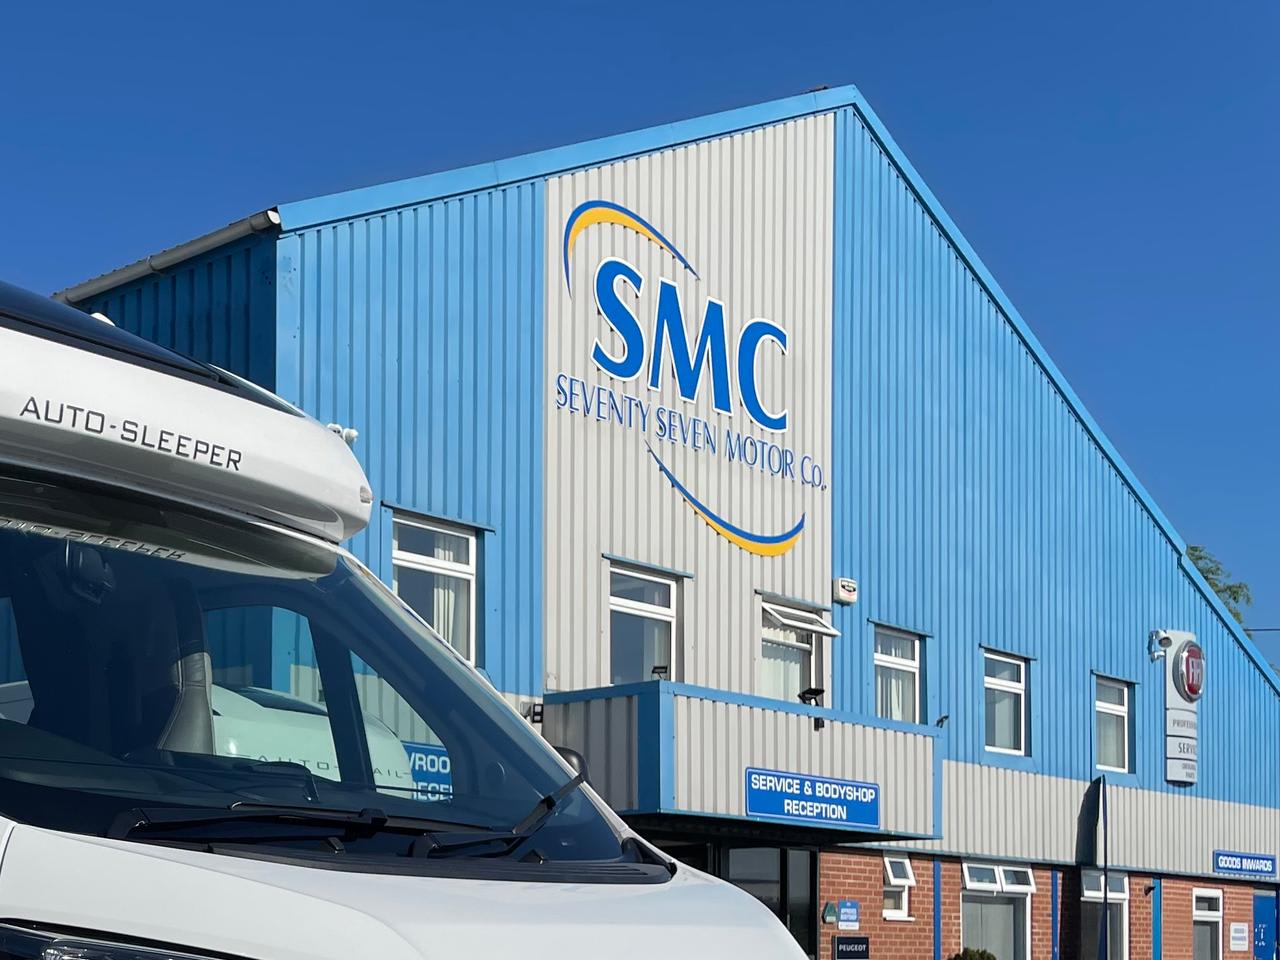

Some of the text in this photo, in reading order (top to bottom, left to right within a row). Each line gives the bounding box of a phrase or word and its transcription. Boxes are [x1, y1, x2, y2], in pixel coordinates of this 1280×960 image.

[591, 257, 789, 433] SMC
[20, 396, 241, 471] AUTO-SLEEPER
[556, 373, 649, 431] SEVENTY
[655, 407, 717, 455] SEVEN
[725, 430, 795, 480] MOTOR
[751, 774, 876, 803] SERVICE & BODYSHOP
[784, 799, 847, 820] RECEPTION
[1218, 856, 1273, 872] GOODS INWARDS
[838, 944, 867, 952] PEUGEOT
